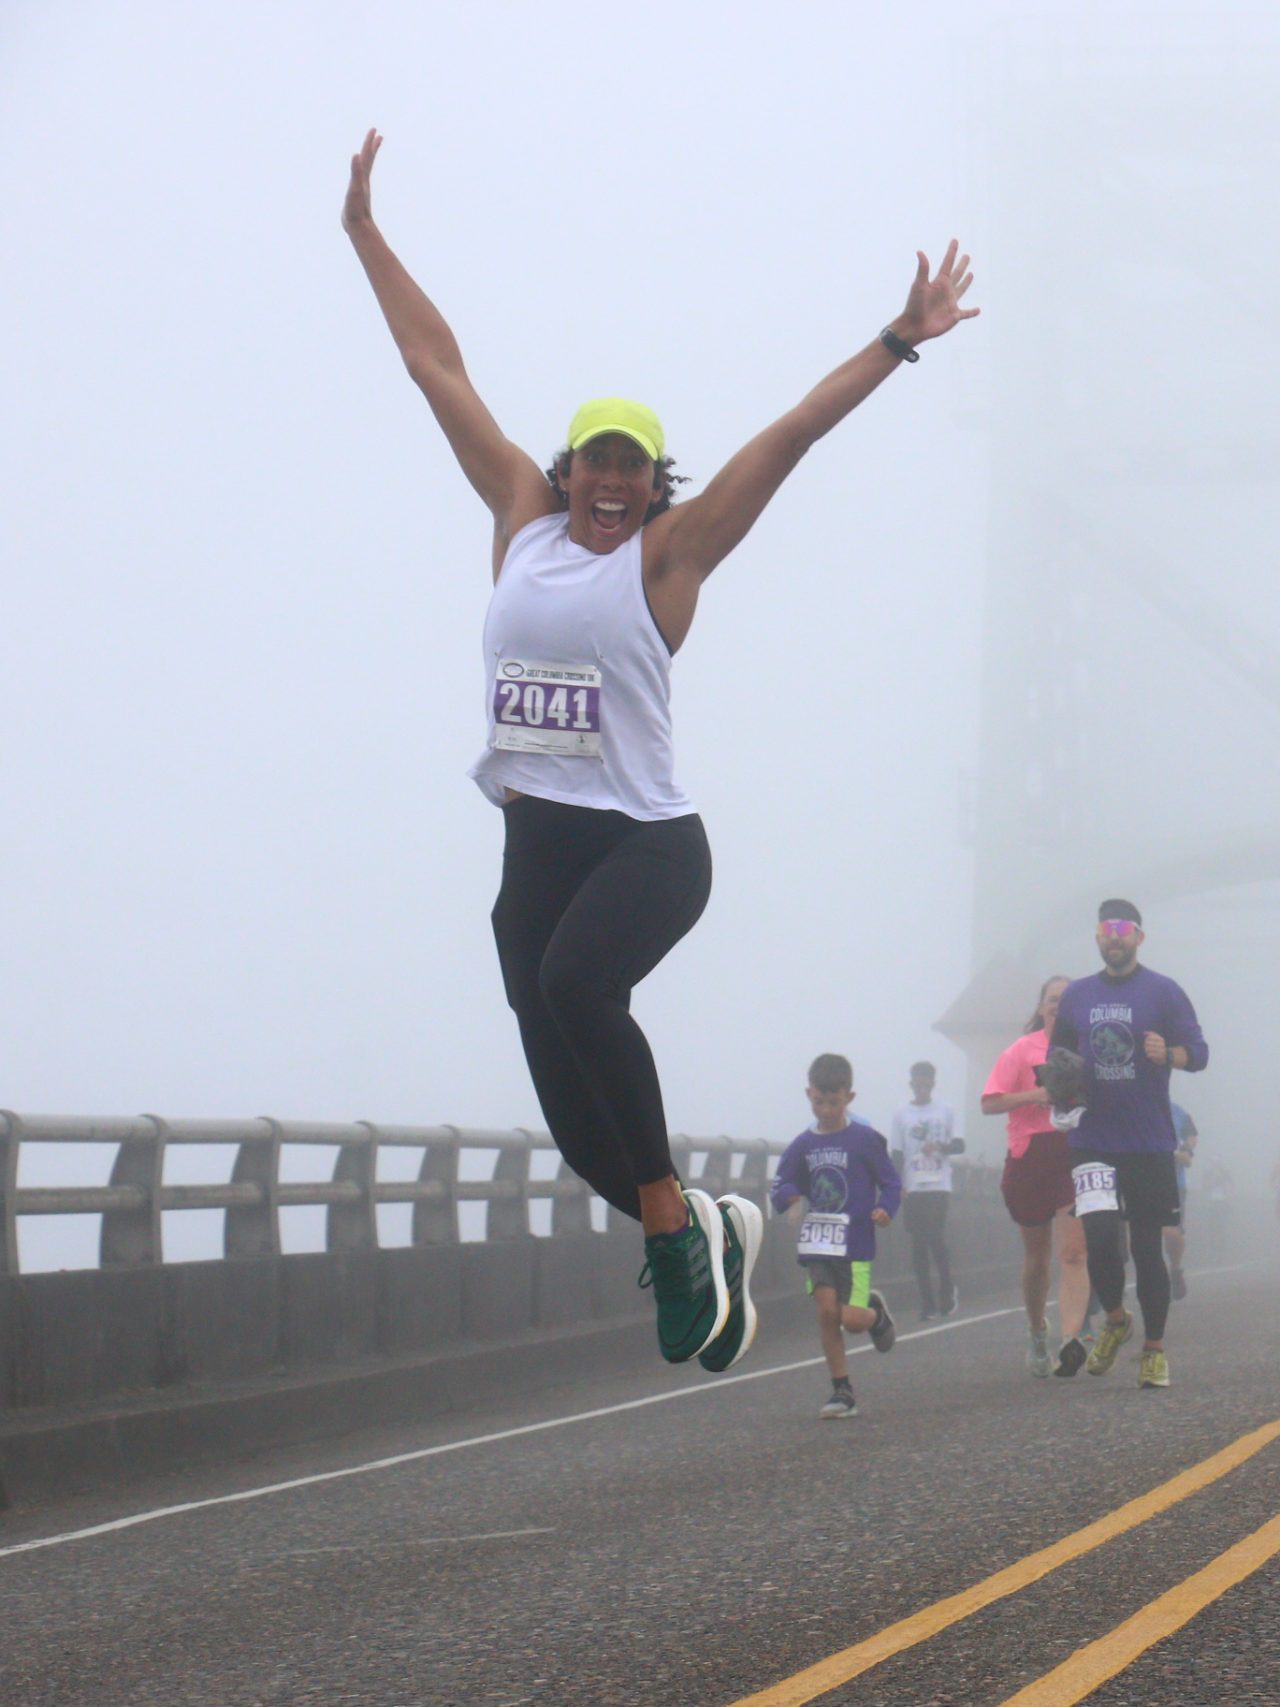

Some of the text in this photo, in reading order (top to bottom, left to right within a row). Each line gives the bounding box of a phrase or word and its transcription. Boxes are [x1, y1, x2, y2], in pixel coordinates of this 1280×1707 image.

[500, 683, 591, 729] 2041
[1090, 1007, 1132, 1024] COLUMBIA
[1094, 1062, 1135, 1081] CROSSING
[1074, 1171, 1114, 1195] 2185
[800, 1223, 845, 1244] 5096
